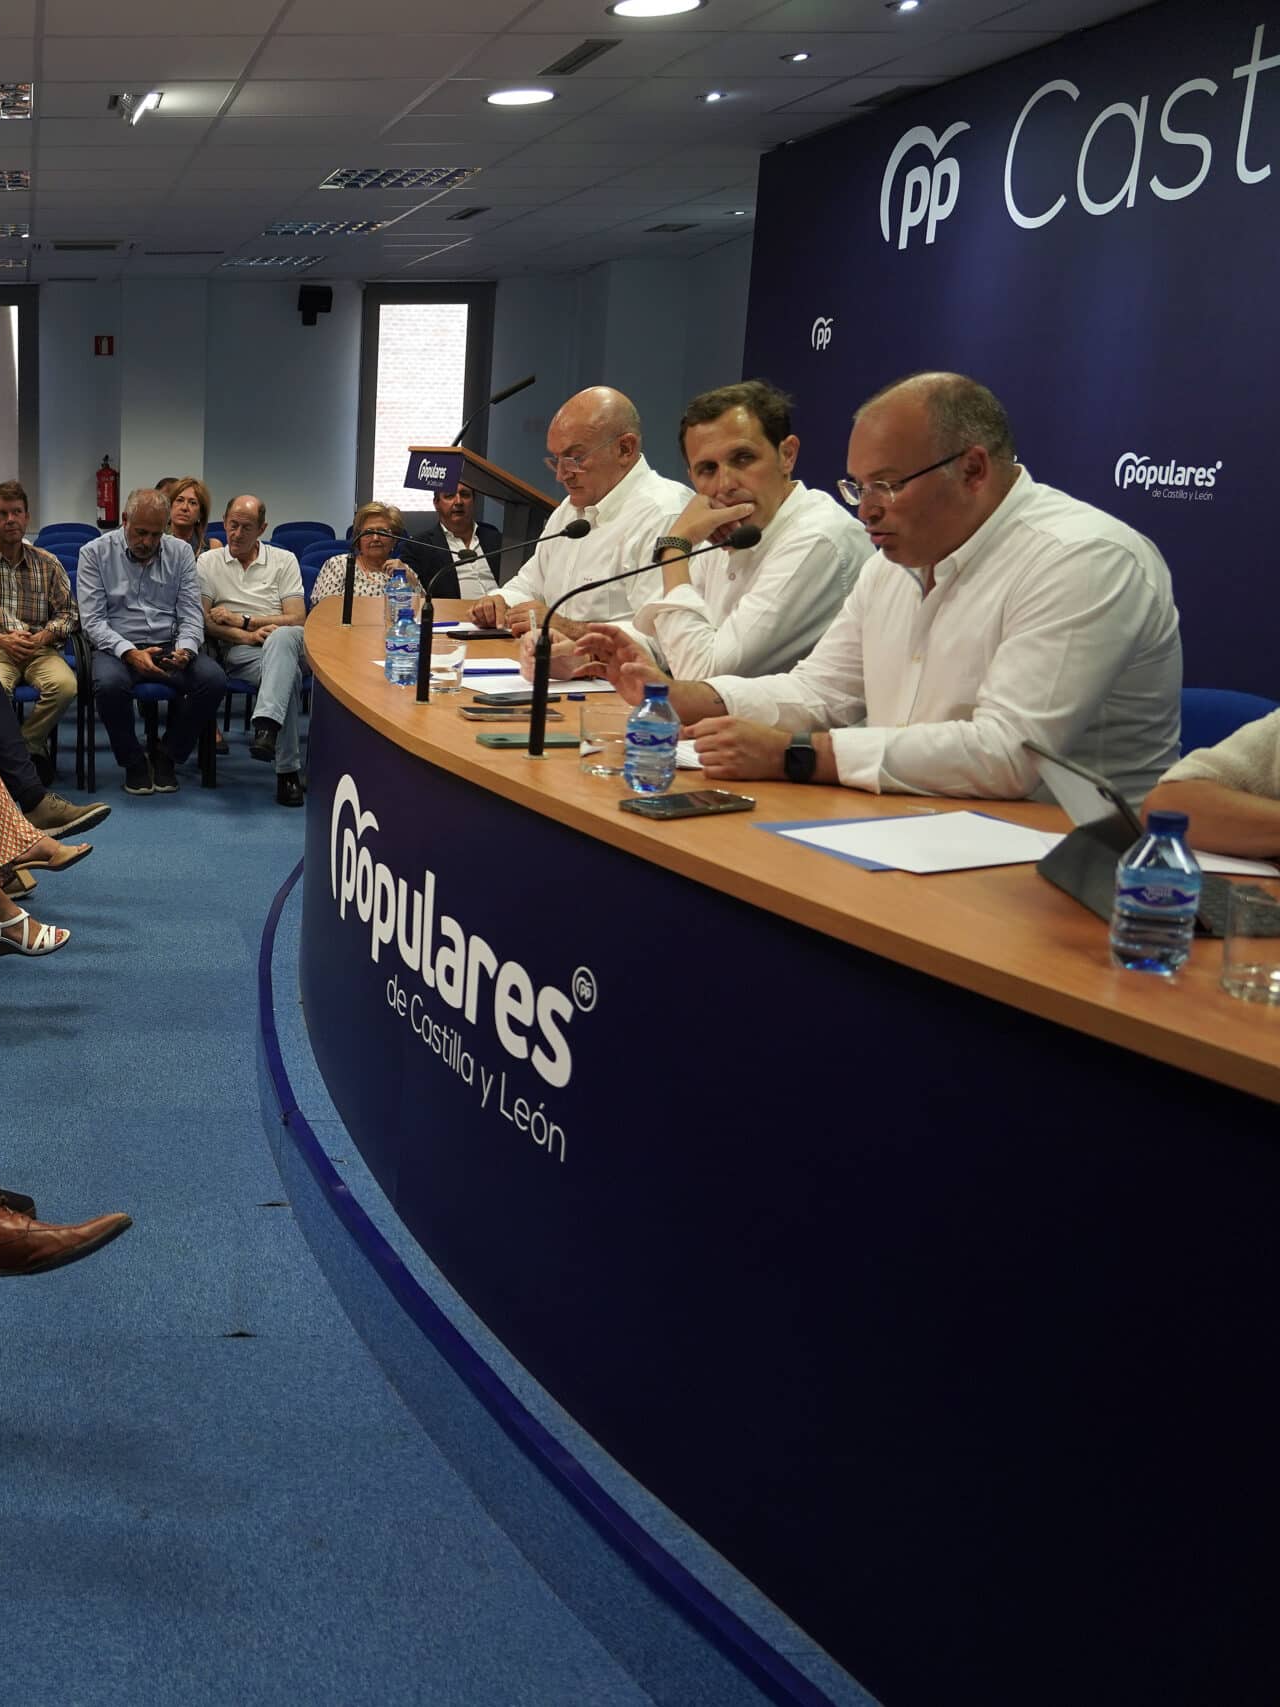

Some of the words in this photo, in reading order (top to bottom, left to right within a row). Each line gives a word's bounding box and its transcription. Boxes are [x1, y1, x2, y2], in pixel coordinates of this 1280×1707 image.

[1004, 23, 1280, 229] Cast
[1115, 452, 1216, 490] populares
[331, 774, 574, 1088] populares
[387, 974, 407, 1016] de
[411, 994, 474, 1085] Castilla
[481, 1066, 494, 1108] y
[500, 1072, 565, 1162] León
